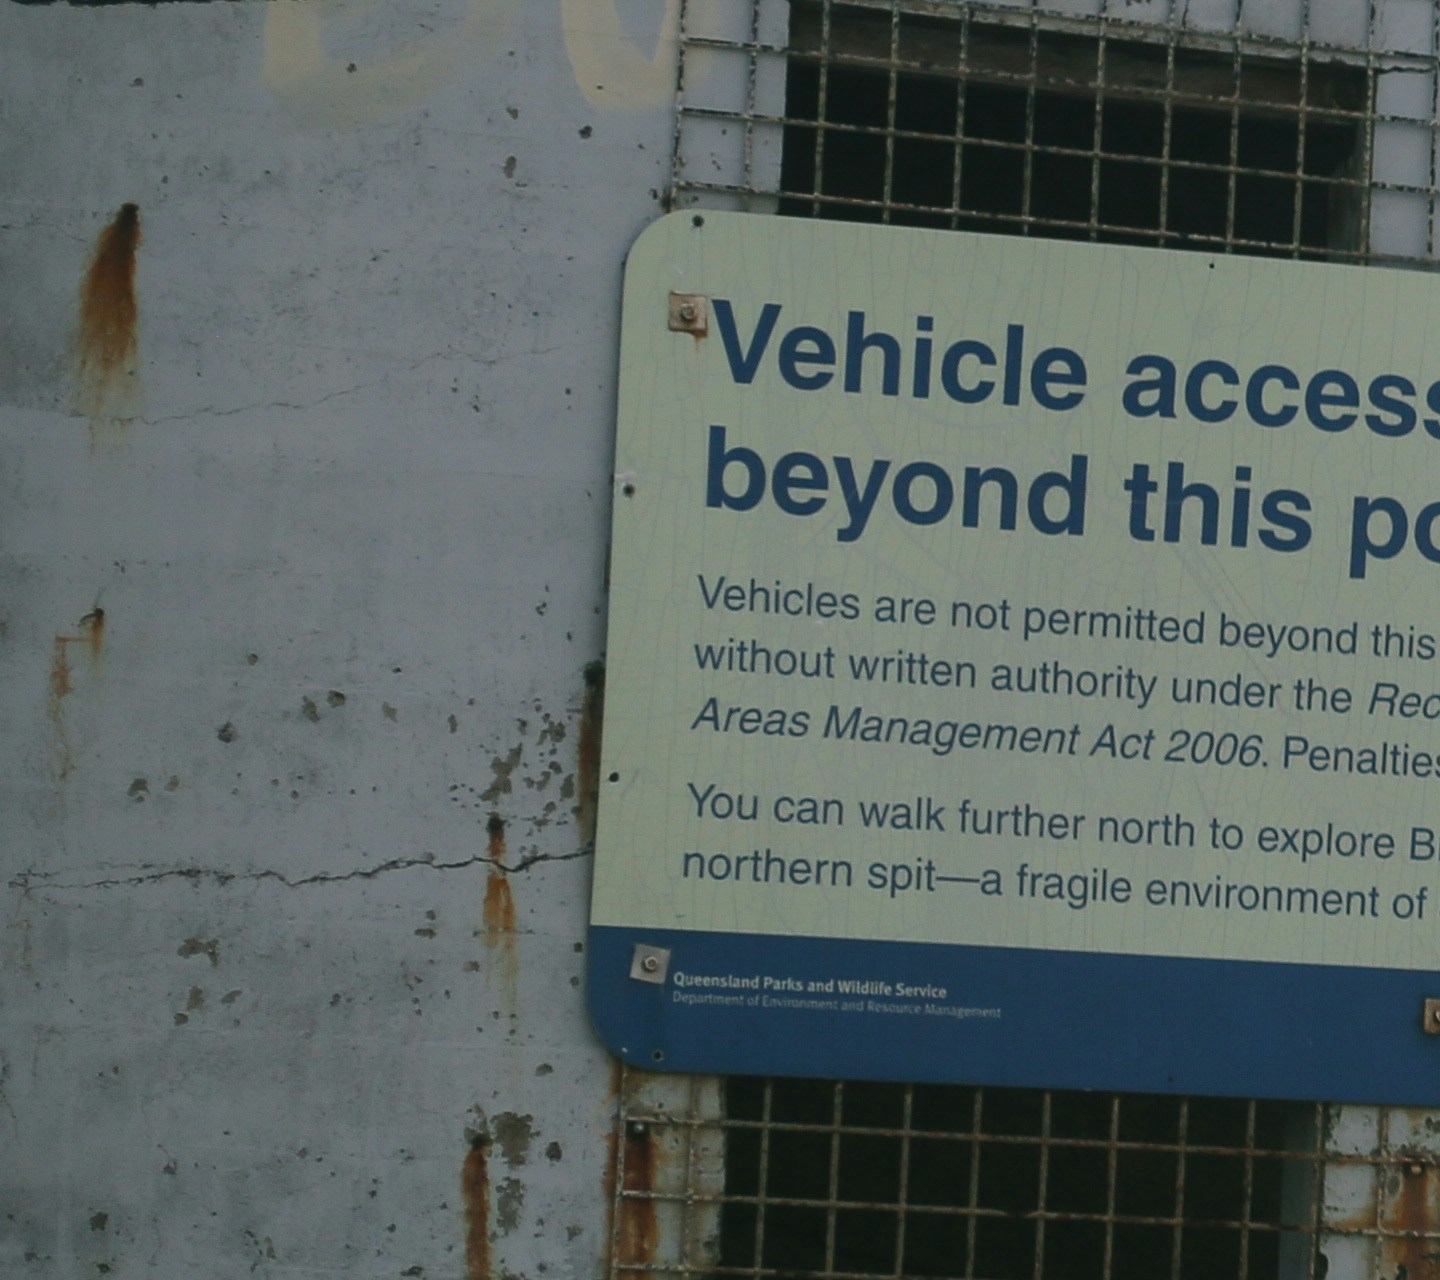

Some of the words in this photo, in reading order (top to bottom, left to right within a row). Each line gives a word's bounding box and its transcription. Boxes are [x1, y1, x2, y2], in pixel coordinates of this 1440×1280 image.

[711, 298, 1088, 412] Vehicle
[706, 425, 1088, 542] beyond
[1124, 462, 1311, 552] this
[698, 575, 859, 619] Vehicles
[875, 597, 935, 625] are
[952, 600, 1010, 630] not
[1024, 606, 1204, 644] permitted
[1220, 612, 1357, 658] beyond
[1372, 624, 1435, 659] this
[694, 638, 835, 678] without
[849, 650, 975, 688] written
[991, 661, 1157, 709] authority
[1173, 674, 1282, 708] under
[1294, 678, 1352, 713] the
[691, 697, 810, 736] Areas
[823, 705, 1080, 756] Management
[1089, 724, 1155, 760] Act
[1164, 730, 1267, 767] 2006.
[687, 783, 758, 820] You
[774, 797, 843, 825] can
[859, 797, 945, 831] walk
[959, 800, 1085, 839] further
[1099, 814, 1194, 847] north
[1210, 818, 1243, 849] to
[1258, 823, 1394, 862] explore
[683, 848, 852, 886] northern
[1017, 863, 1131, 909] fragile
[1146, 875, 1379, 917] environment
[1393, 887, 1427, 919] of
[673, 971, 760, 990] Queensland
[764, 977, 803, 991] Parks
[807, 979, 834, 992] and
[838, 980, 892, 995] Wildlife
[896, 983, 946, 998] Service
